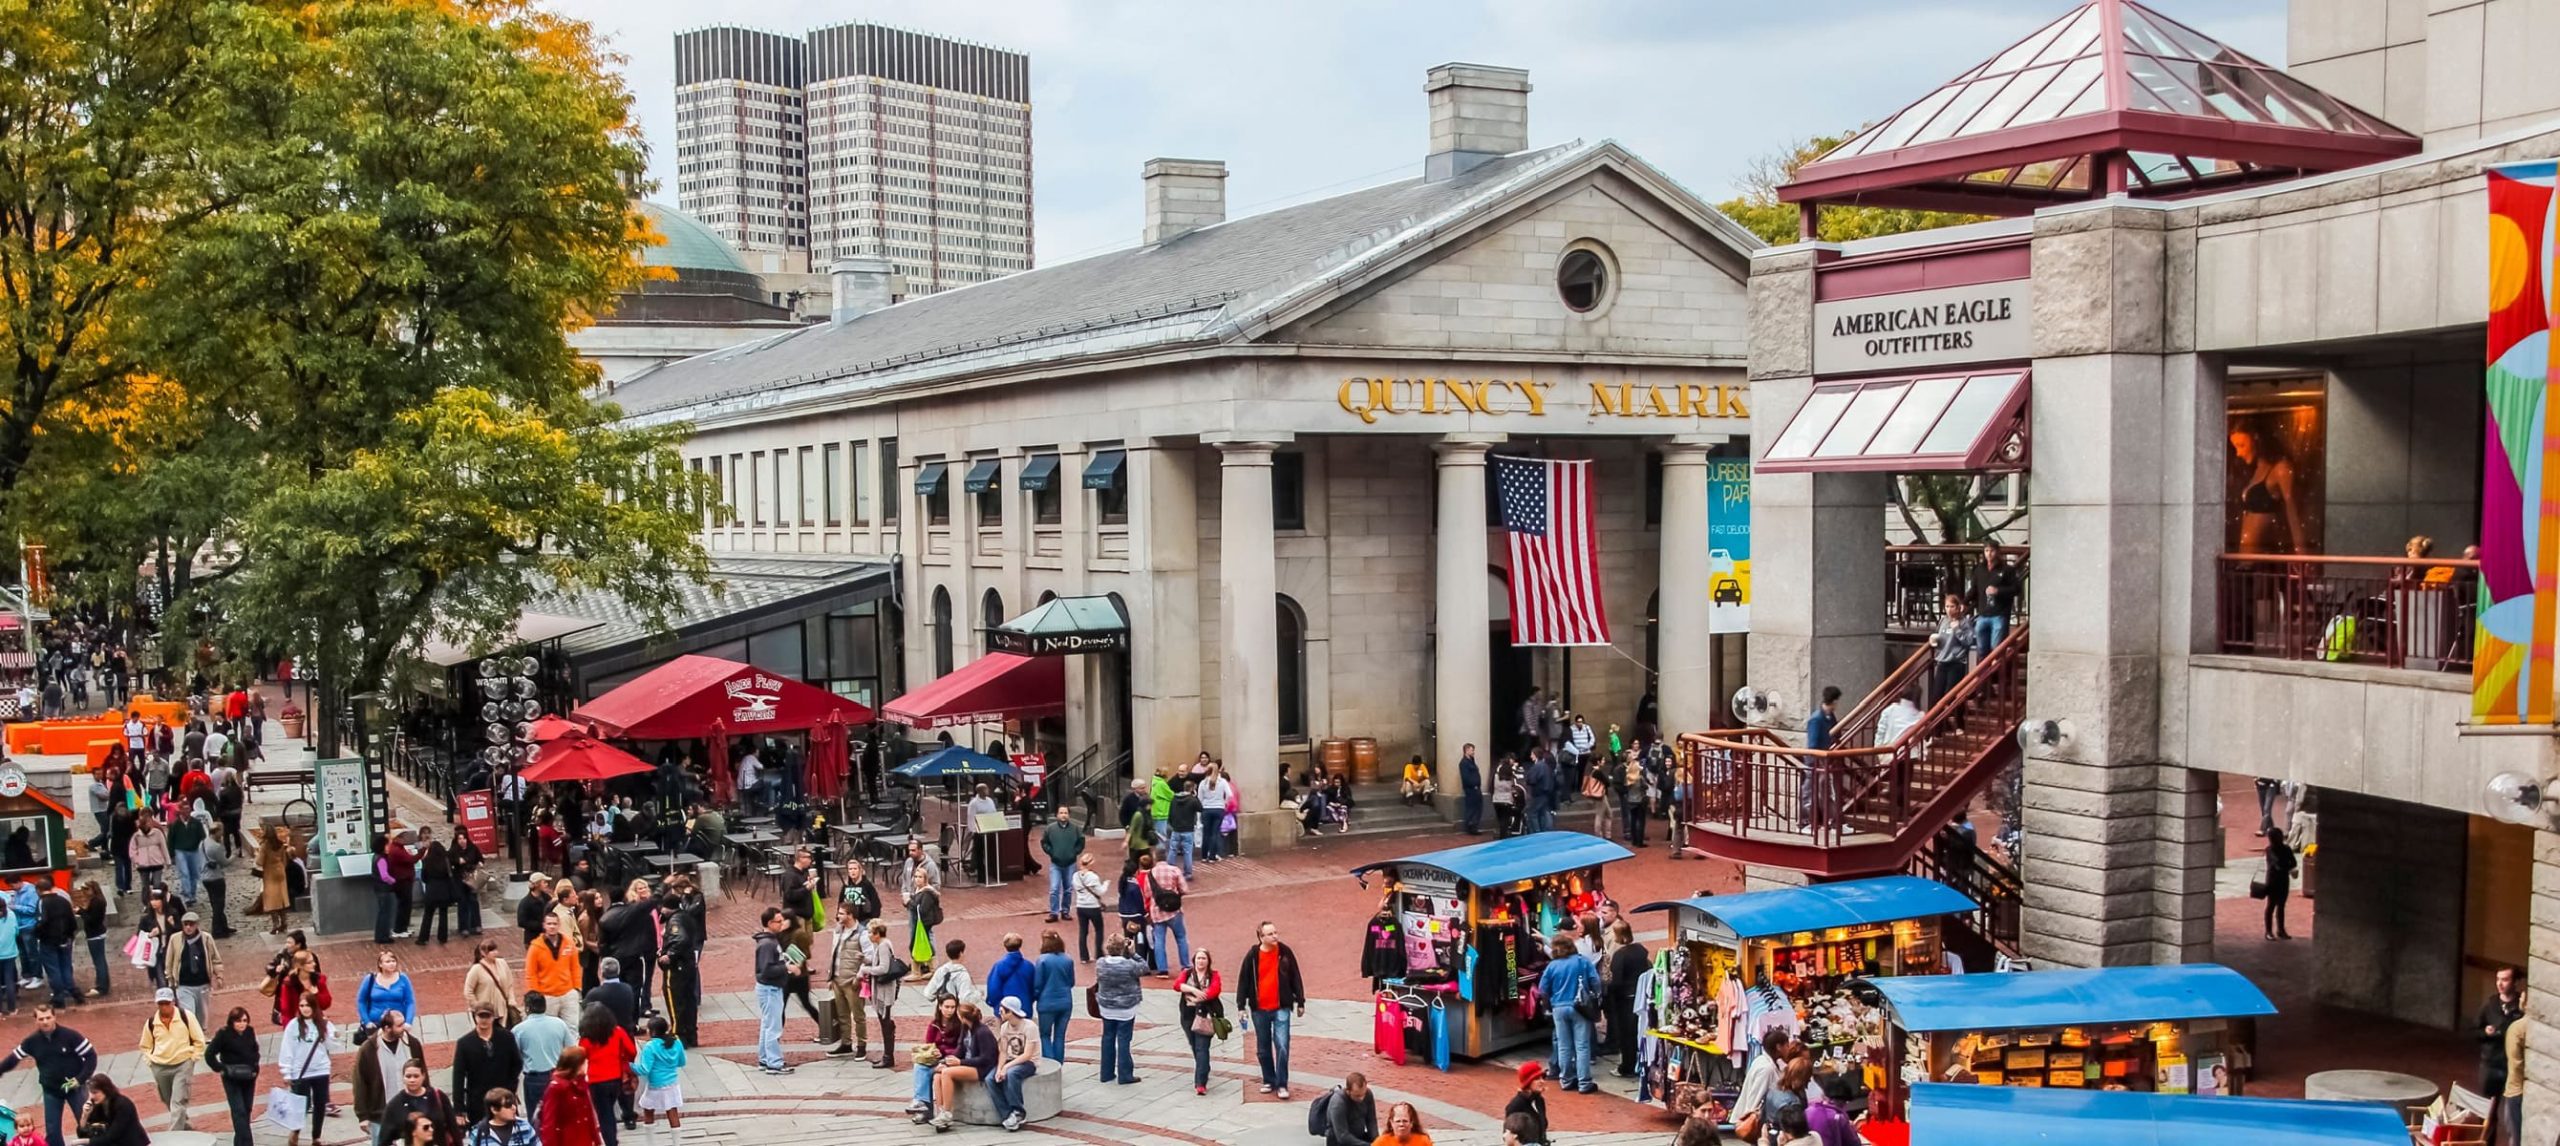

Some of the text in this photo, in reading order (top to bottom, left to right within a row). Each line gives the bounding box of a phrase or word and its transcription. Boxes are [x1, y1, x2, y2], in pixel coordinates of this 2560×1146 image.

[1832, 297, 2012, 337] AMERICAN EAGLE
[1865, 330, 1973, 357] OUTFITTERS
[1337, 376, 1751, 424] QUINCY MARK
[1711, 525, 1726, 535] FAST
[755, 673, 784, 692] PLOW
[733, 709, 776, 722] TAVERN
